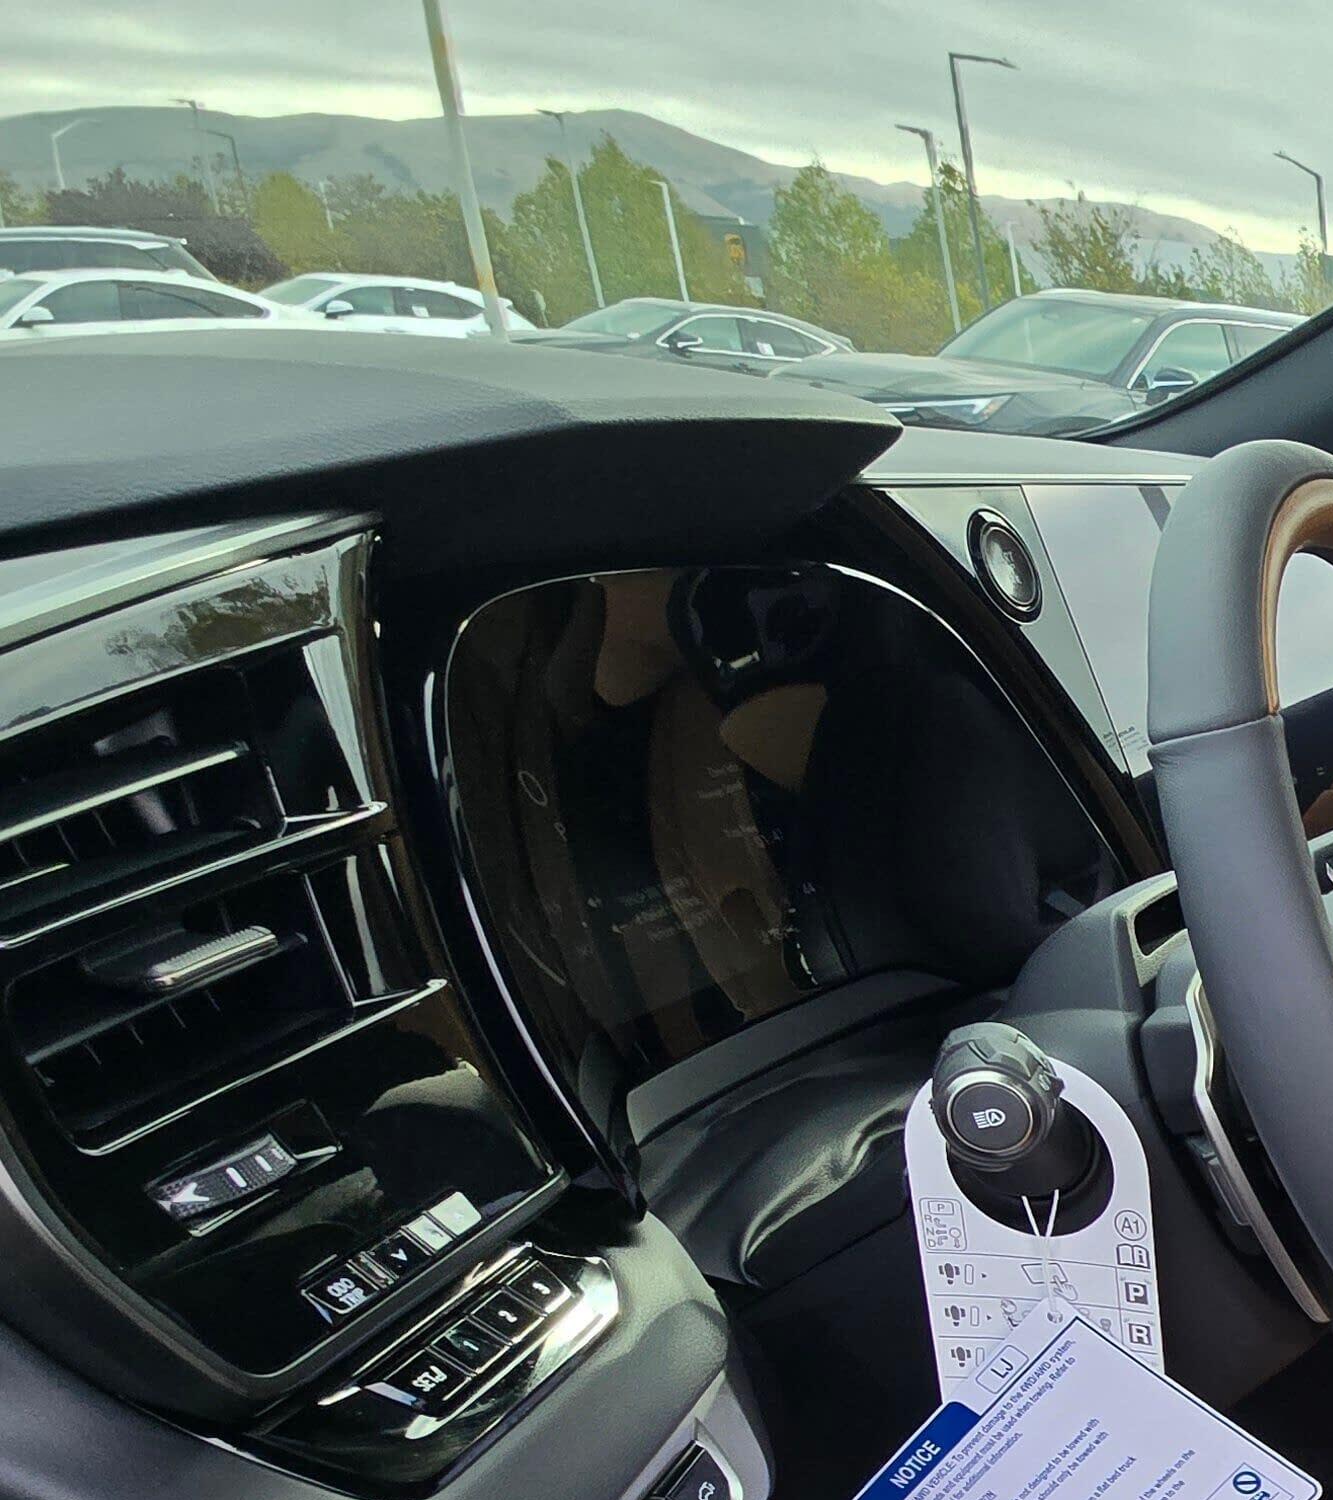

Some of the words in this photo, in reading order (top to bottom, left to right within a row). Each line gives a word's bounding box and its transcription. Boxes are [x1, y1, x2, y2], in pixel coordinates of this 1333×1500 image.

[1121, 1217, 1140, 1234] A1
[1129, 1286, 1146, 1302] P
[498, 1310, 518, 1323] 2
[463, 1340, 479, 1352] 1
[1132, 1327, 1150, 1345] R
[990, 1358, 1015, 1379] LJ
[999, 1415, 1017, 1432] used
[1013, 1400, 1032, 1418] when
[1049, 1363, 1068, 1381] Refer
[959, 1430, 986, 1456] prevent
[980, 1407, 1008, 1434] damage
[1026, 1462, 1057, 1491] designed
[1065, 1430, 1087, 1450] towed
[1083, 1417, 1099, 1433] with
[1075, 1443, 1096, 1462] towed
[1092, 1430, 1108, 1445] with
[888, 1438, 942, 1489] NOTICE
[1117, 1455, 1136, 1472] truck
[1152, 1466, 1176, 1489] wheels
